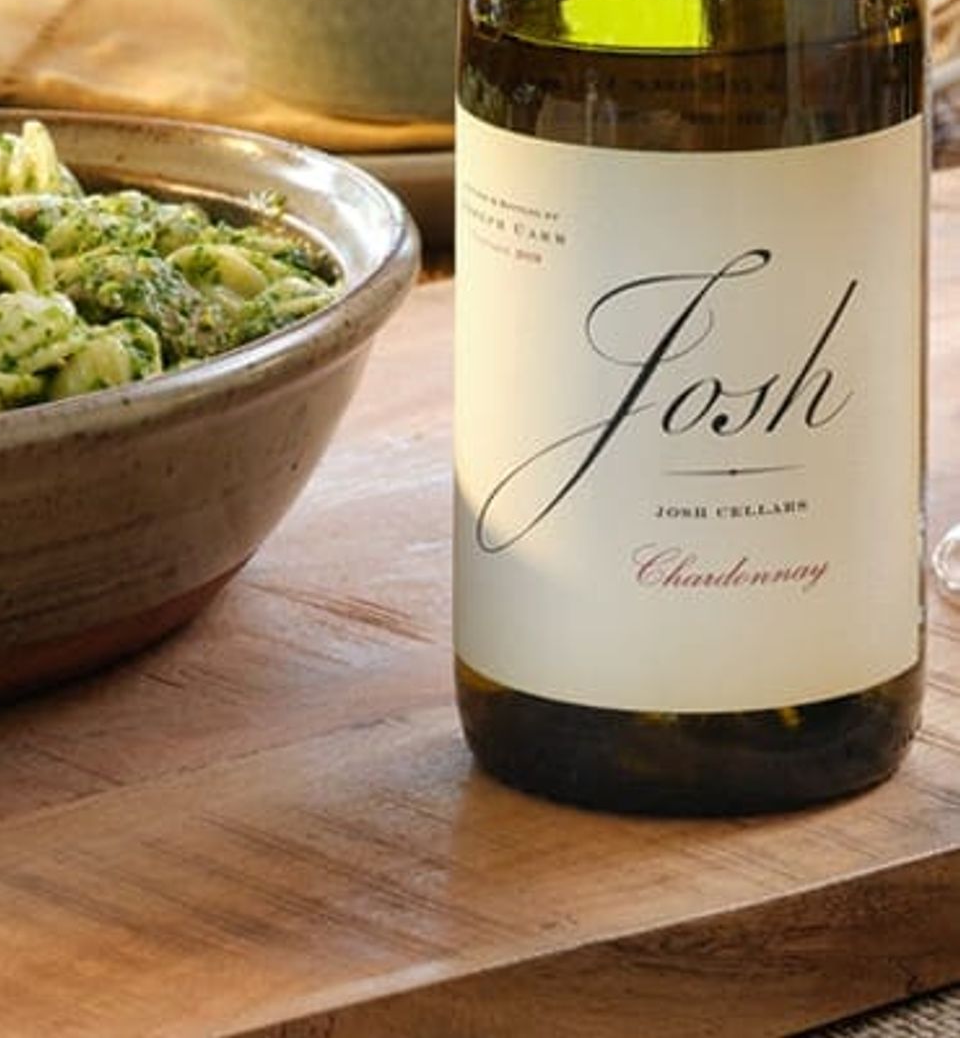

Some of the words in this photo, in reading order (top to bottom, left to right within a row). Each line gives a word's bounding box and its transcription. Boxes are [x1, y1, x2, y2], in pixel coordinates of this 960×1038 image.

[477, 249, 857, 554] Josh
[654, 505, 708, 519] JOSH
[715, 501, 808, 518] CELLARS
[632, 543, 829, 593] Chardonnay
